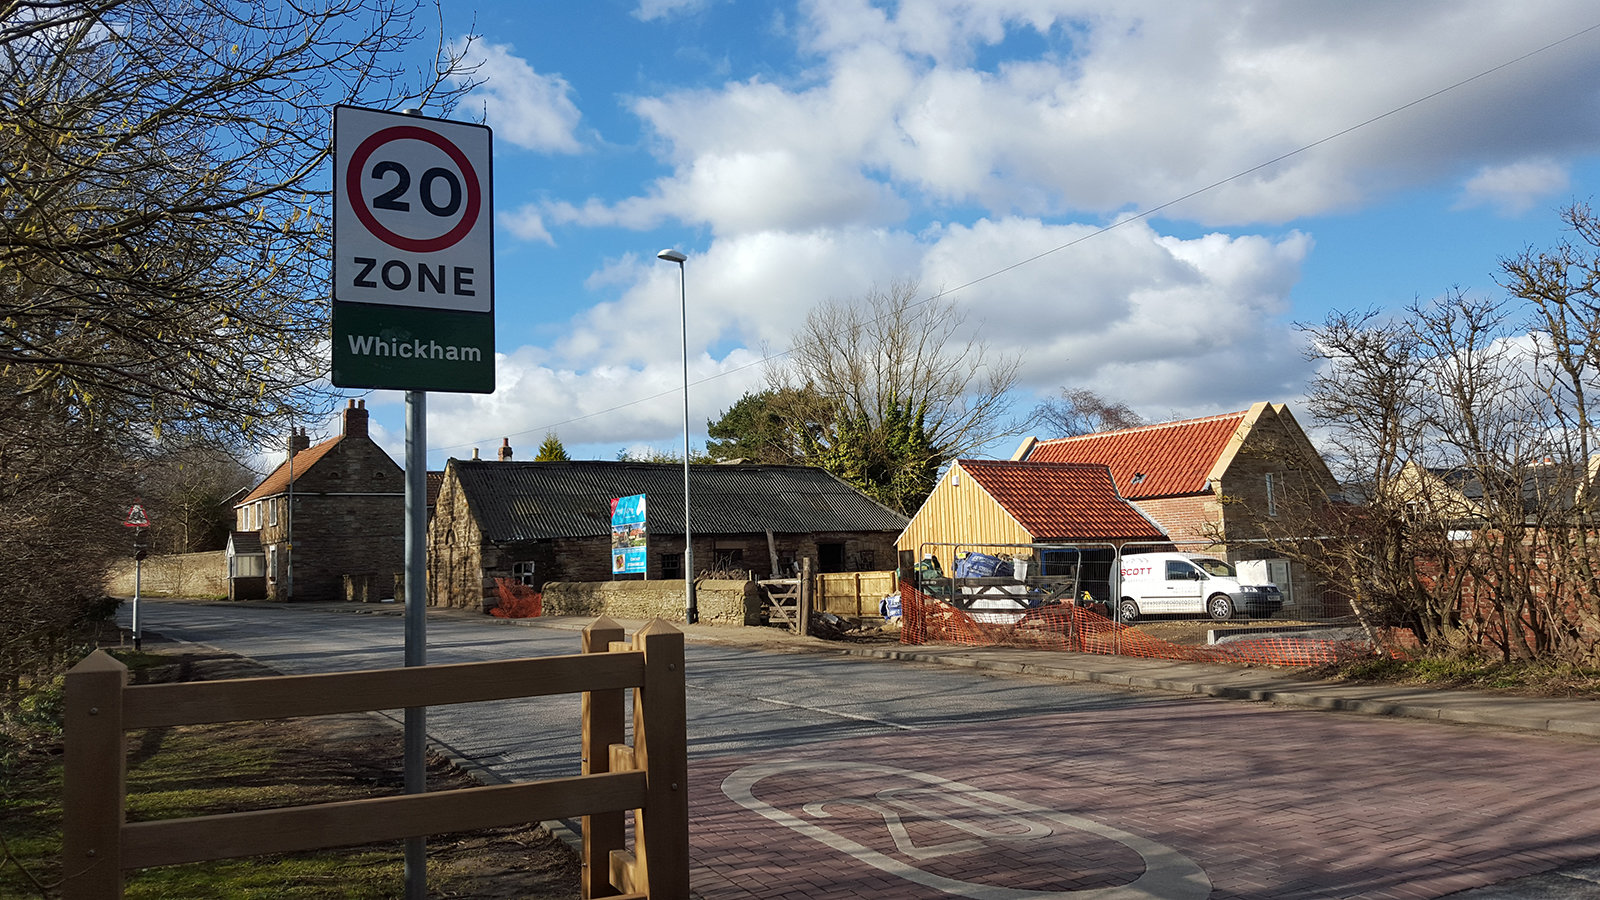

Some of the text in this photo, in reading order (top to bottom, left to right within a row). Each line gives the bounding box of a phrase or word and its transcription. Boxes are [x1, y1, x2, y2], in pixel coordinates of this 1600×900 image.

[371, 160, 462, 217] 20
[353, 256, 476, 297] ZONE
[347, 334, 481, 362] Whickham
[1120, 567, 1152, 577] SCOTT
